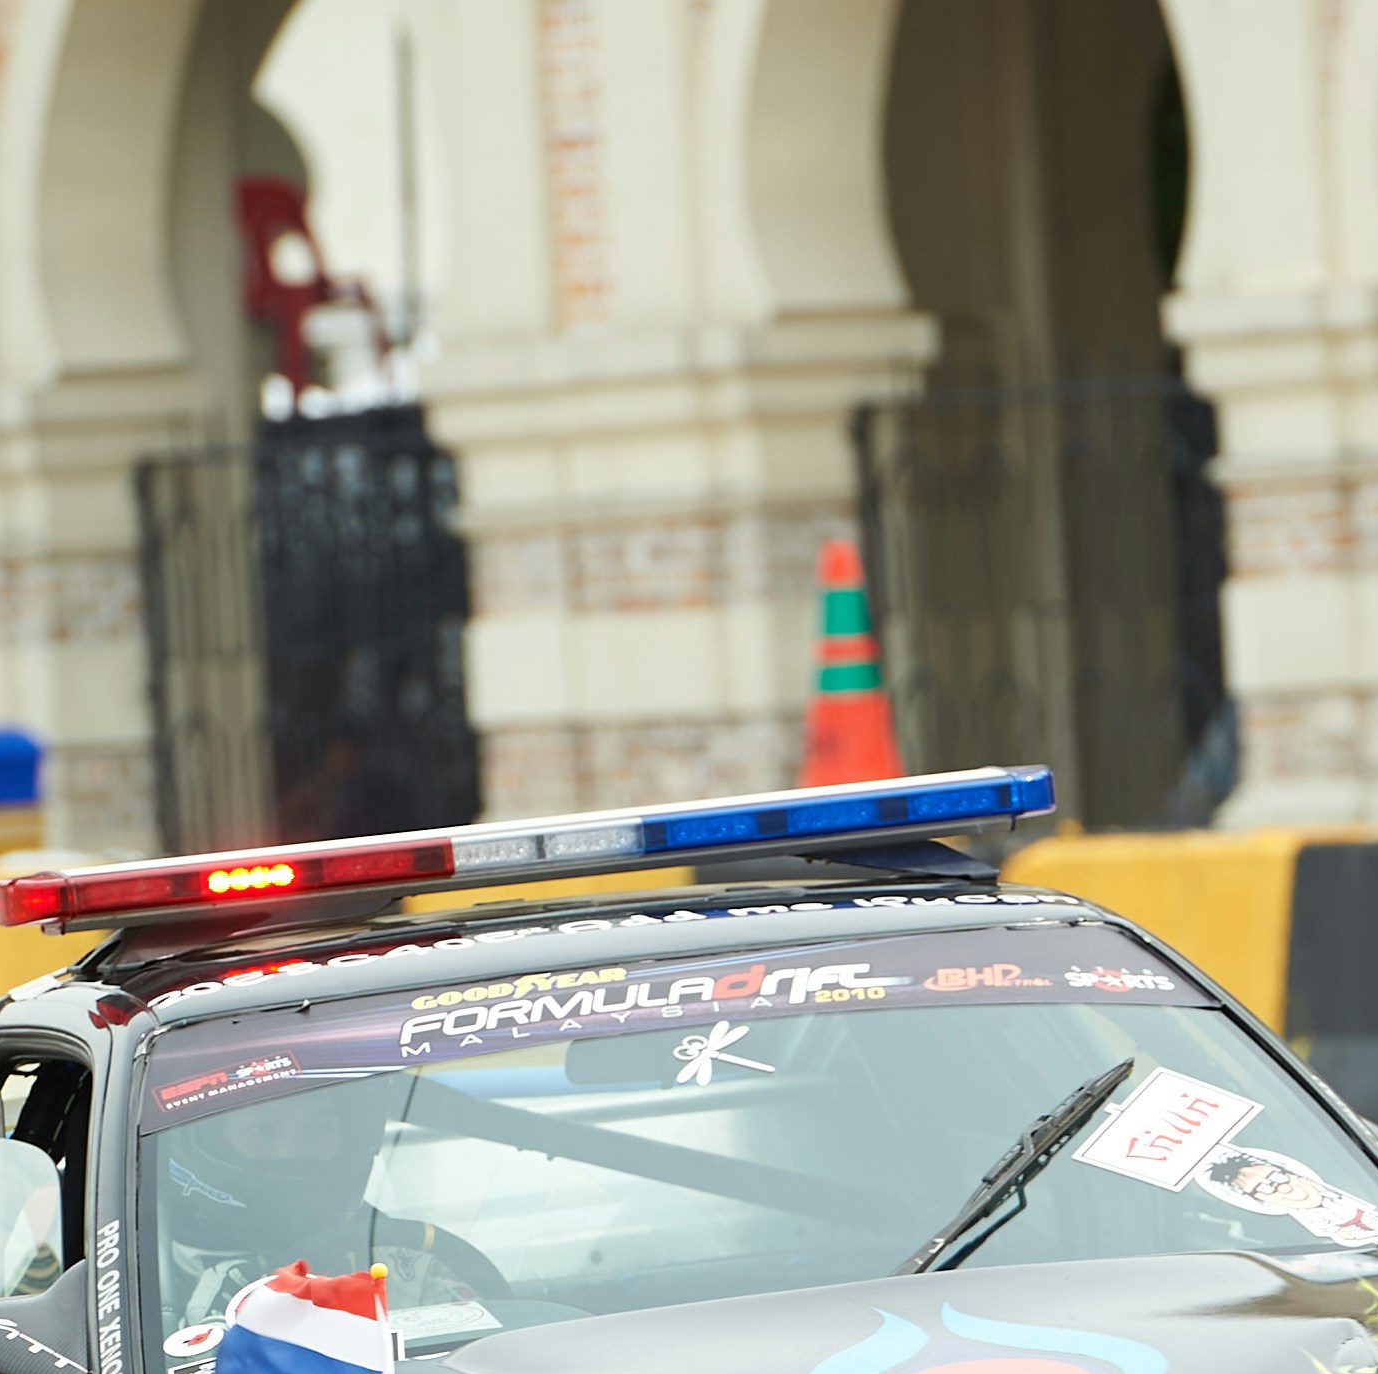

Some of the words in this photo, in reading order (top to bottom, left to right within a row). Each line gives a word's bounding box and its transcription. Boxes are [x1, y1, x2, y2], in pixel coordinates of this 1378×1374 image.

[410, 965, 628, 1011] GOODYEAR
[813, 985, 888, 1004] 2010
[401, 995, 774, 1059] MALAYSIA
[207, 1067, 297, 1098] MANAGEMENT
[96, 1218, 121, 1269] PRO
[96, 1268, 121, 1321] ONE
